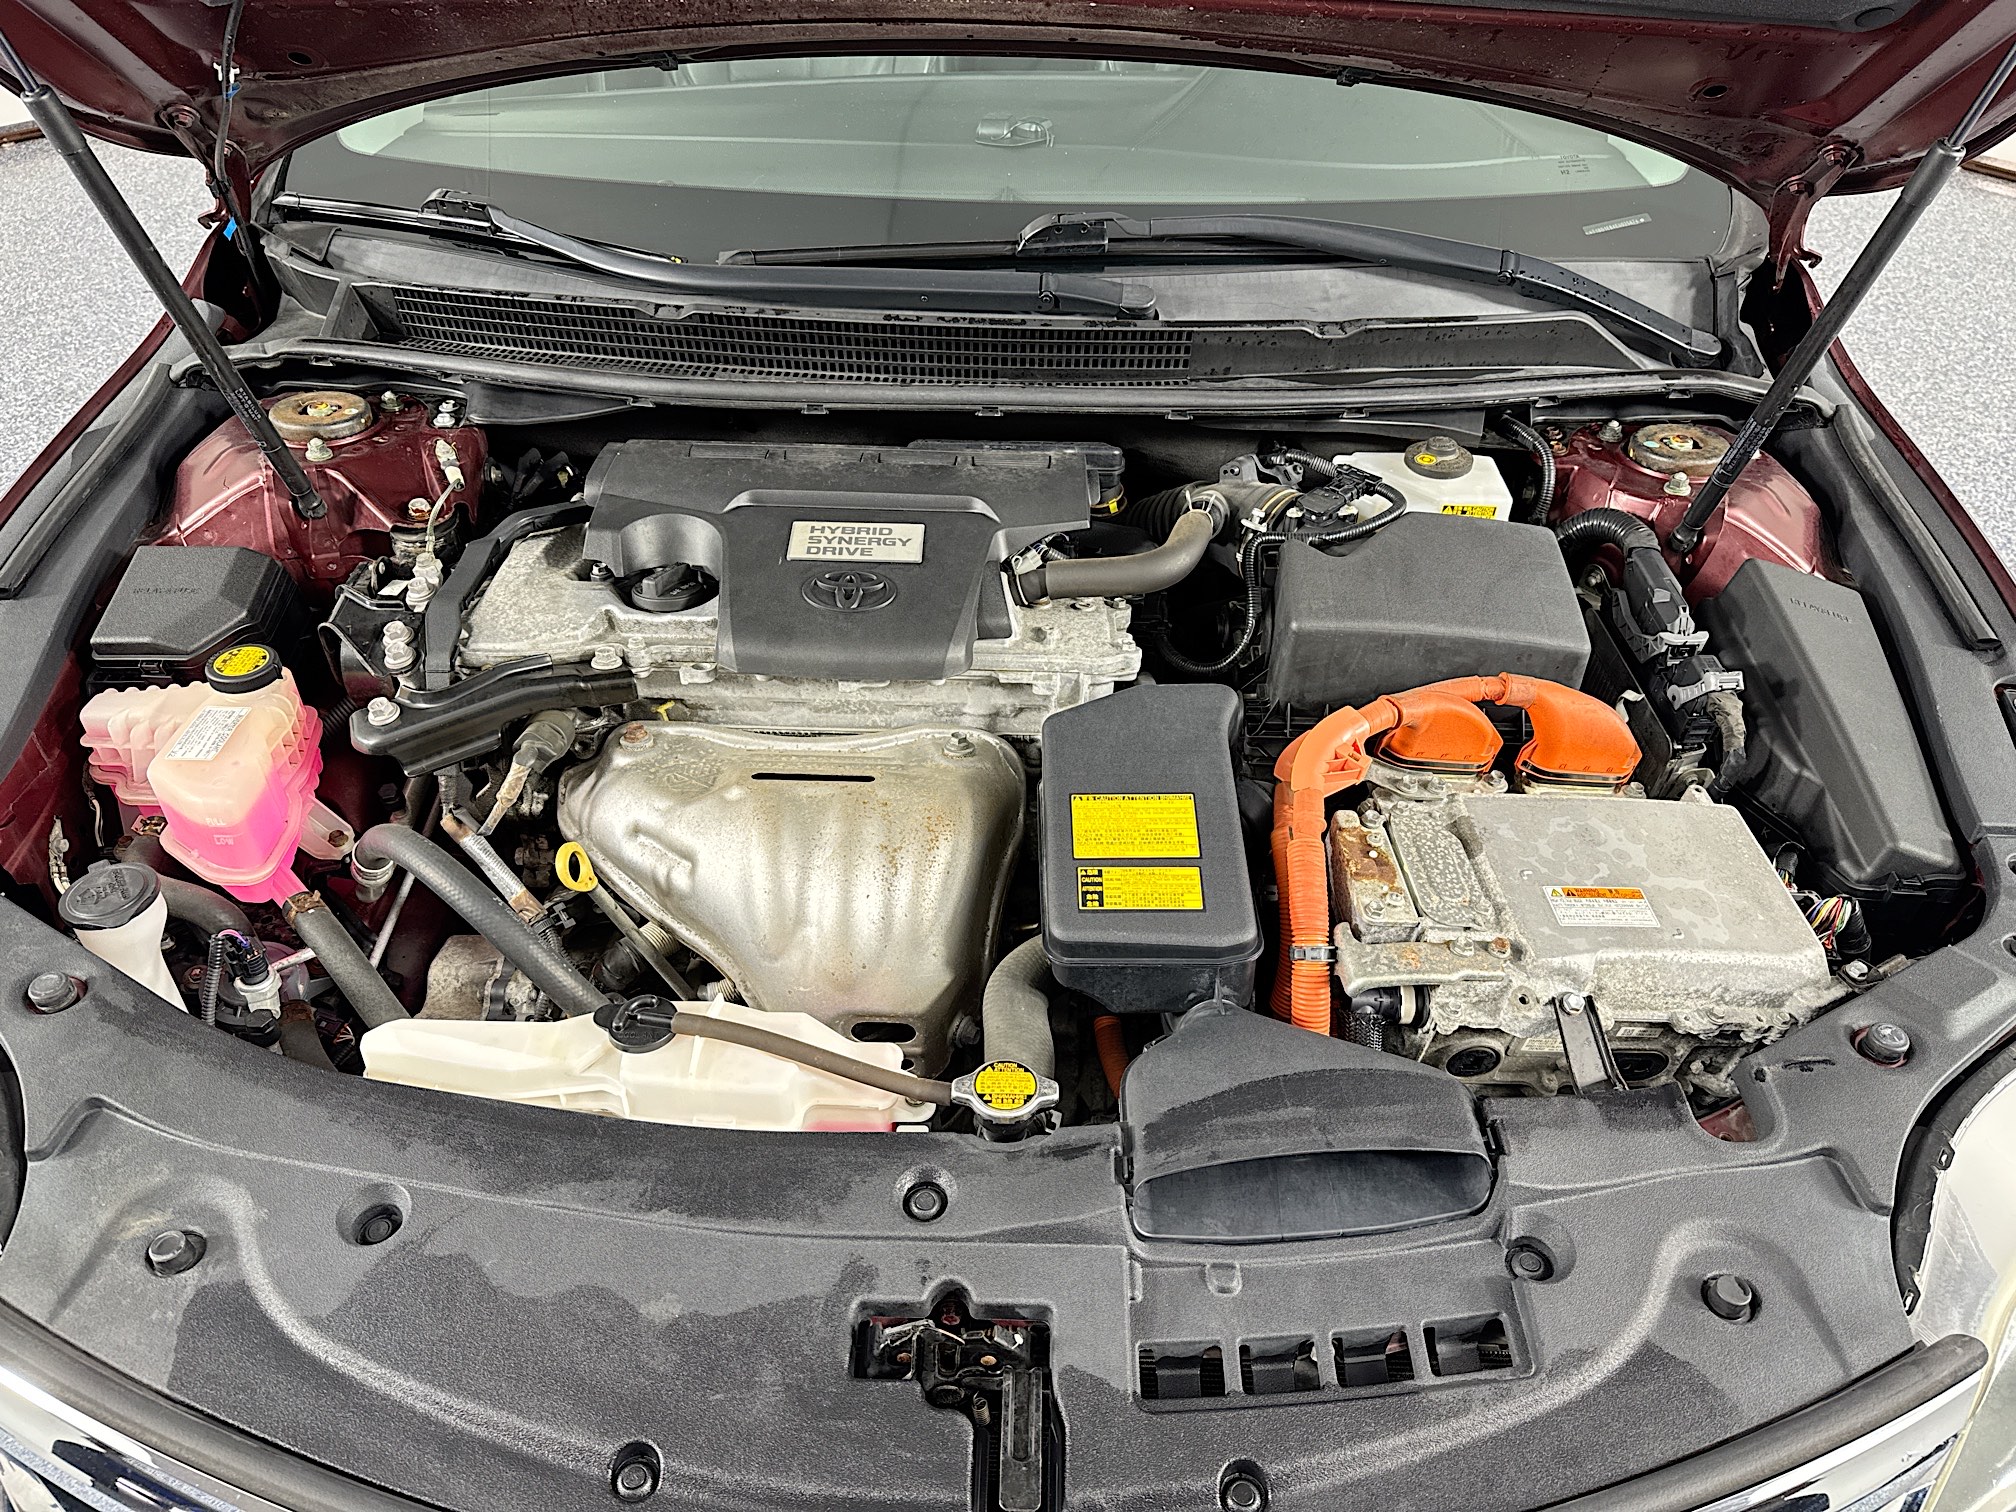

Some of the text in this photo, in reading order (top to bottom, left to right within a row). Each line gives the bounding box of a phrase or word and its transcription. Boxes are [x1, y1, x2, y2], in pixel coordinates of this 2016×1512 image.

[239, 387, 262, 419] STABILUS
[810, 525, 893, 536] HYBRID
[808, 536, 912, 547] SYNERGY
[806, 546, 874, 557] DRIVE
[214, 837, 234, 845] LOW
